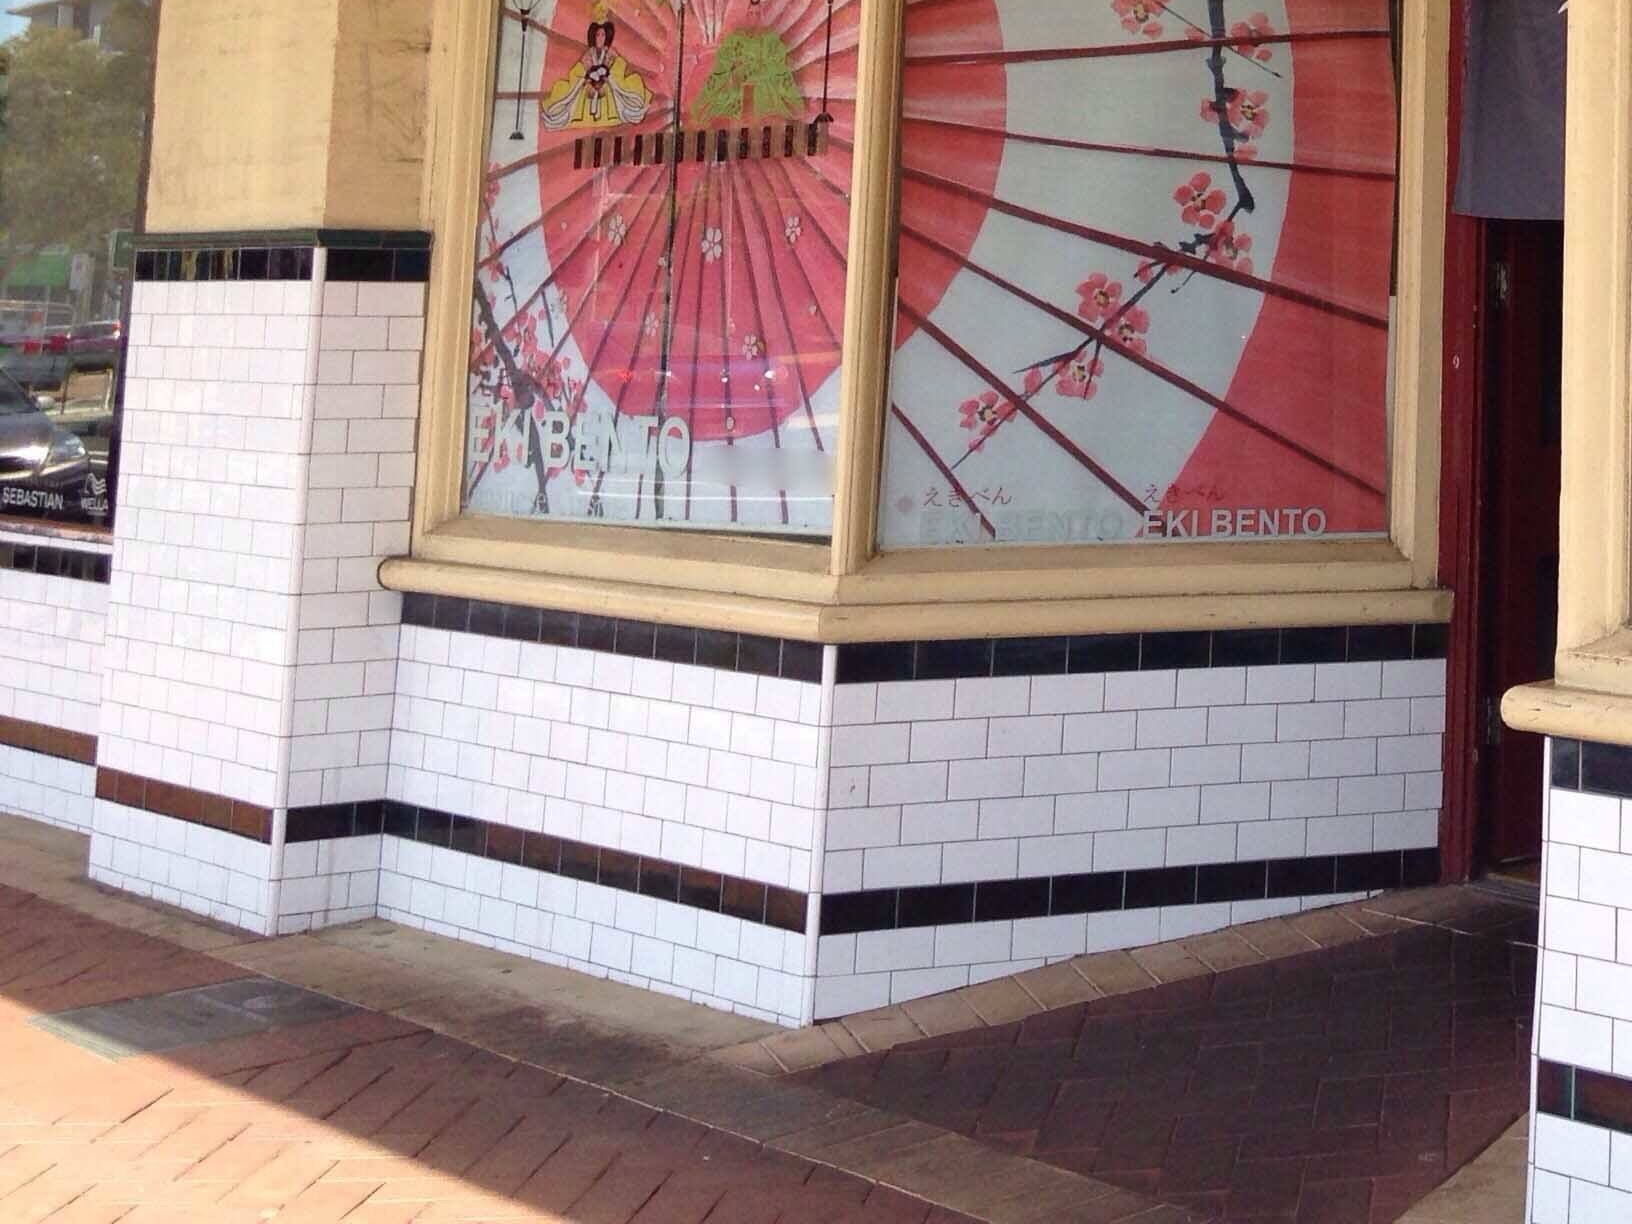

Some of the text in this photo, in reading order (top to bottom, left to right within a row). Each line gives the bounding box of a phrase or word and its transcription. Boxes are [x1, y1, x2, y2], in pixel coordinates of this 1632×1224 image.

[469, 404, 531, 468] EKI
[542, 409, 692, 477] BENTO
[2, 487, 64, 510] SEBASTIAN
[1142, 507, 1327, 538] EKI BENTO
